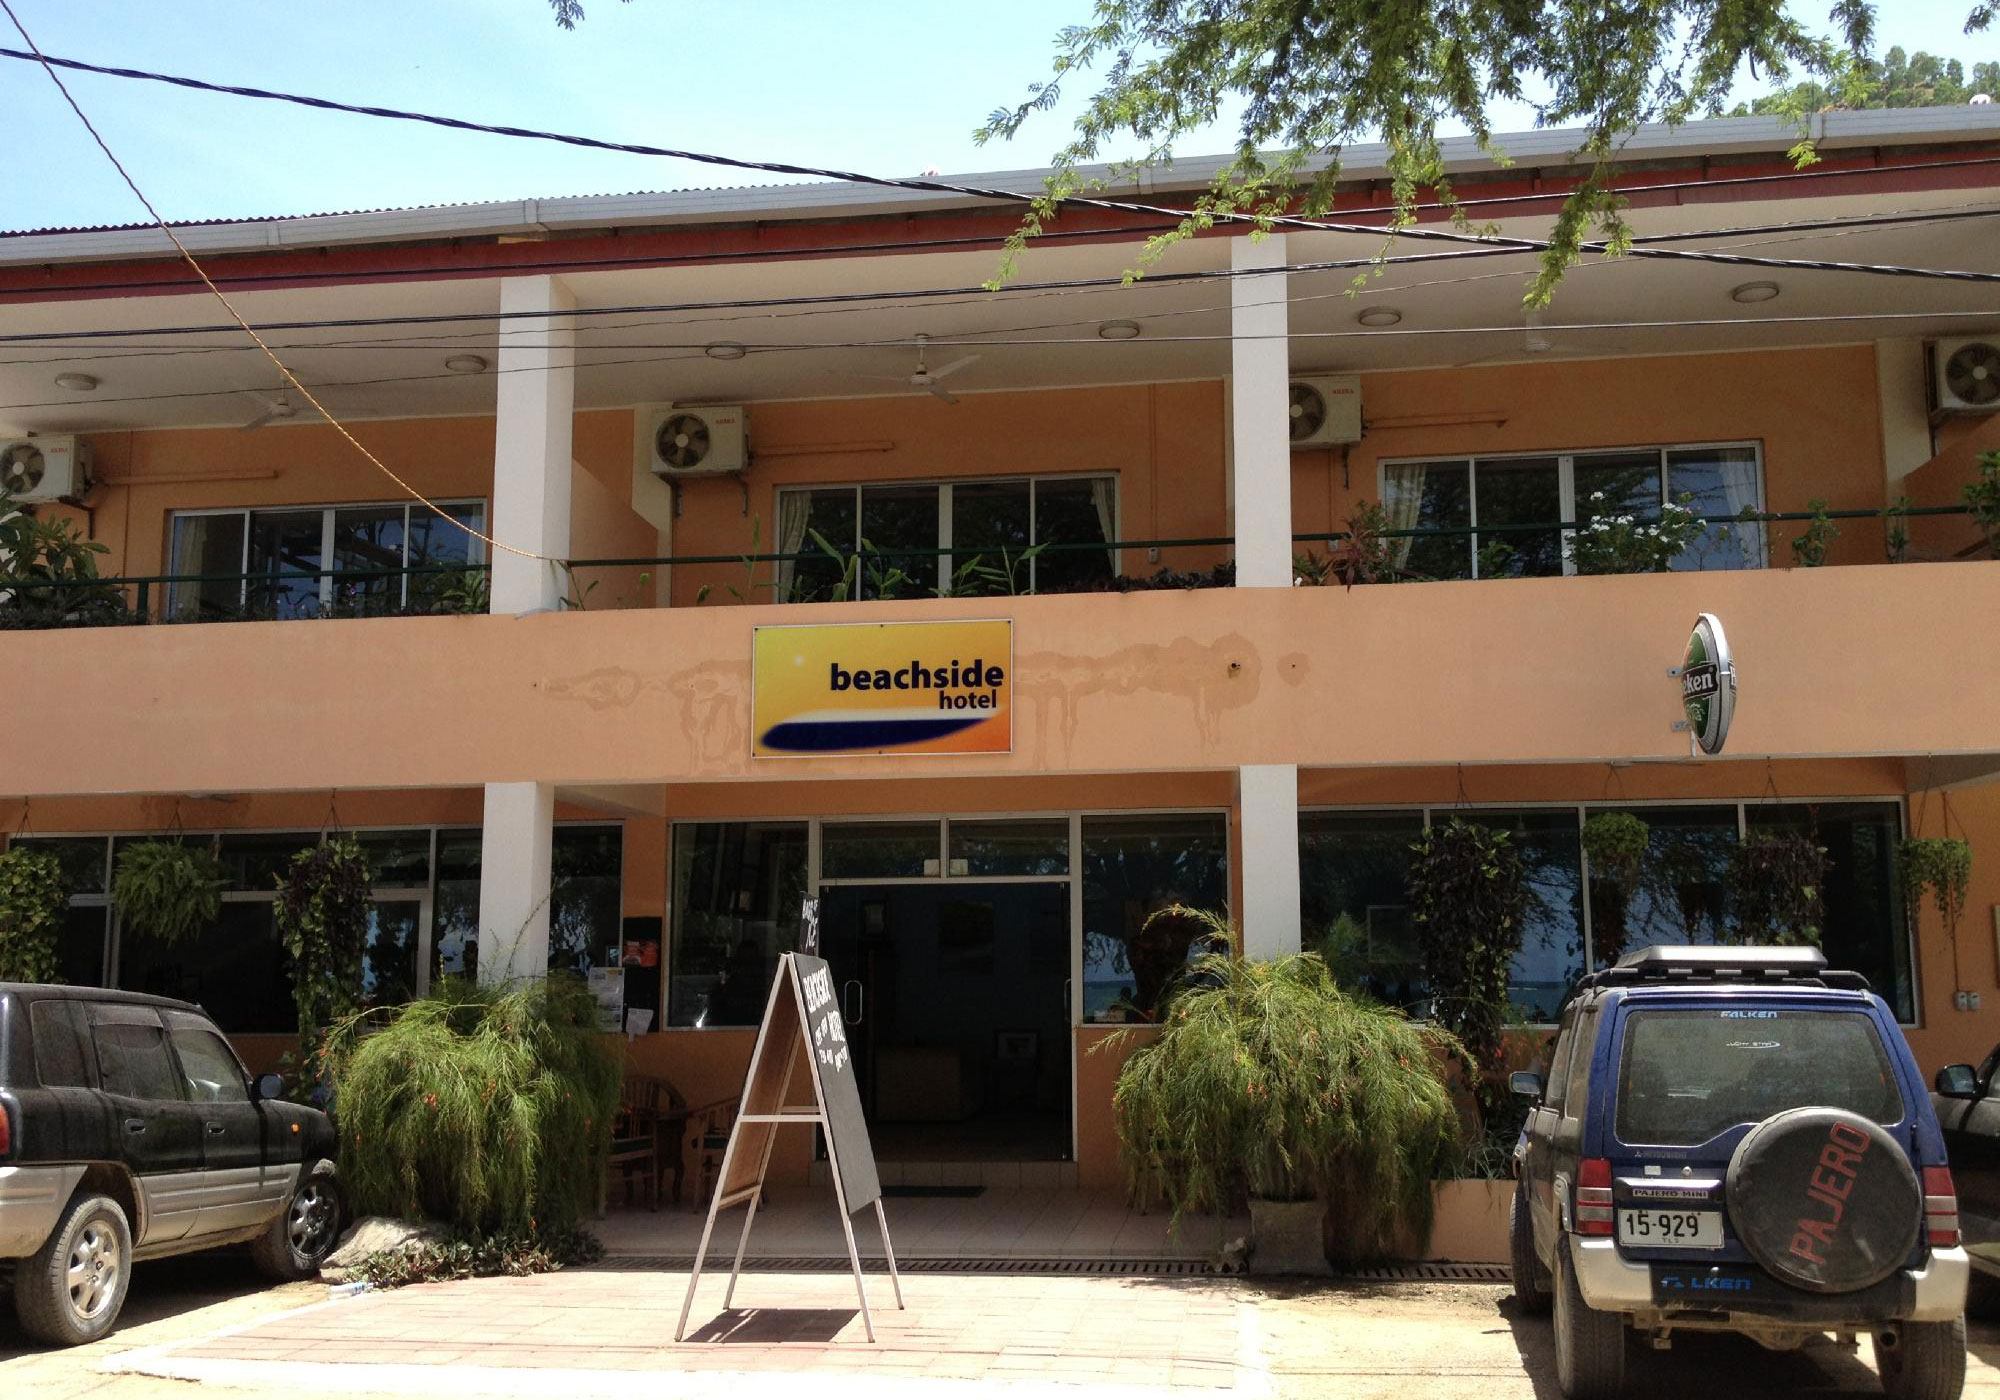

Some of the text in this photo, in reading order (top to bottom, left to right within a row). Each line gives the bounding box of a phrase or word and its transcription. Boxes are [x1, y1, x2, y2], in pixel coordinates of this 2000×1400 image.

[830, 659, 1004, 691] beachside
[939, 689, 997, 710] hotel
[1720, 1010, 1778, 1019] FALKEN
[1634, 1189, 1679, 1197] PAJERO
[1790, 1121, 1872, 1265] PAJERO
[1626, 1213, 1699, 1237] 15-929
